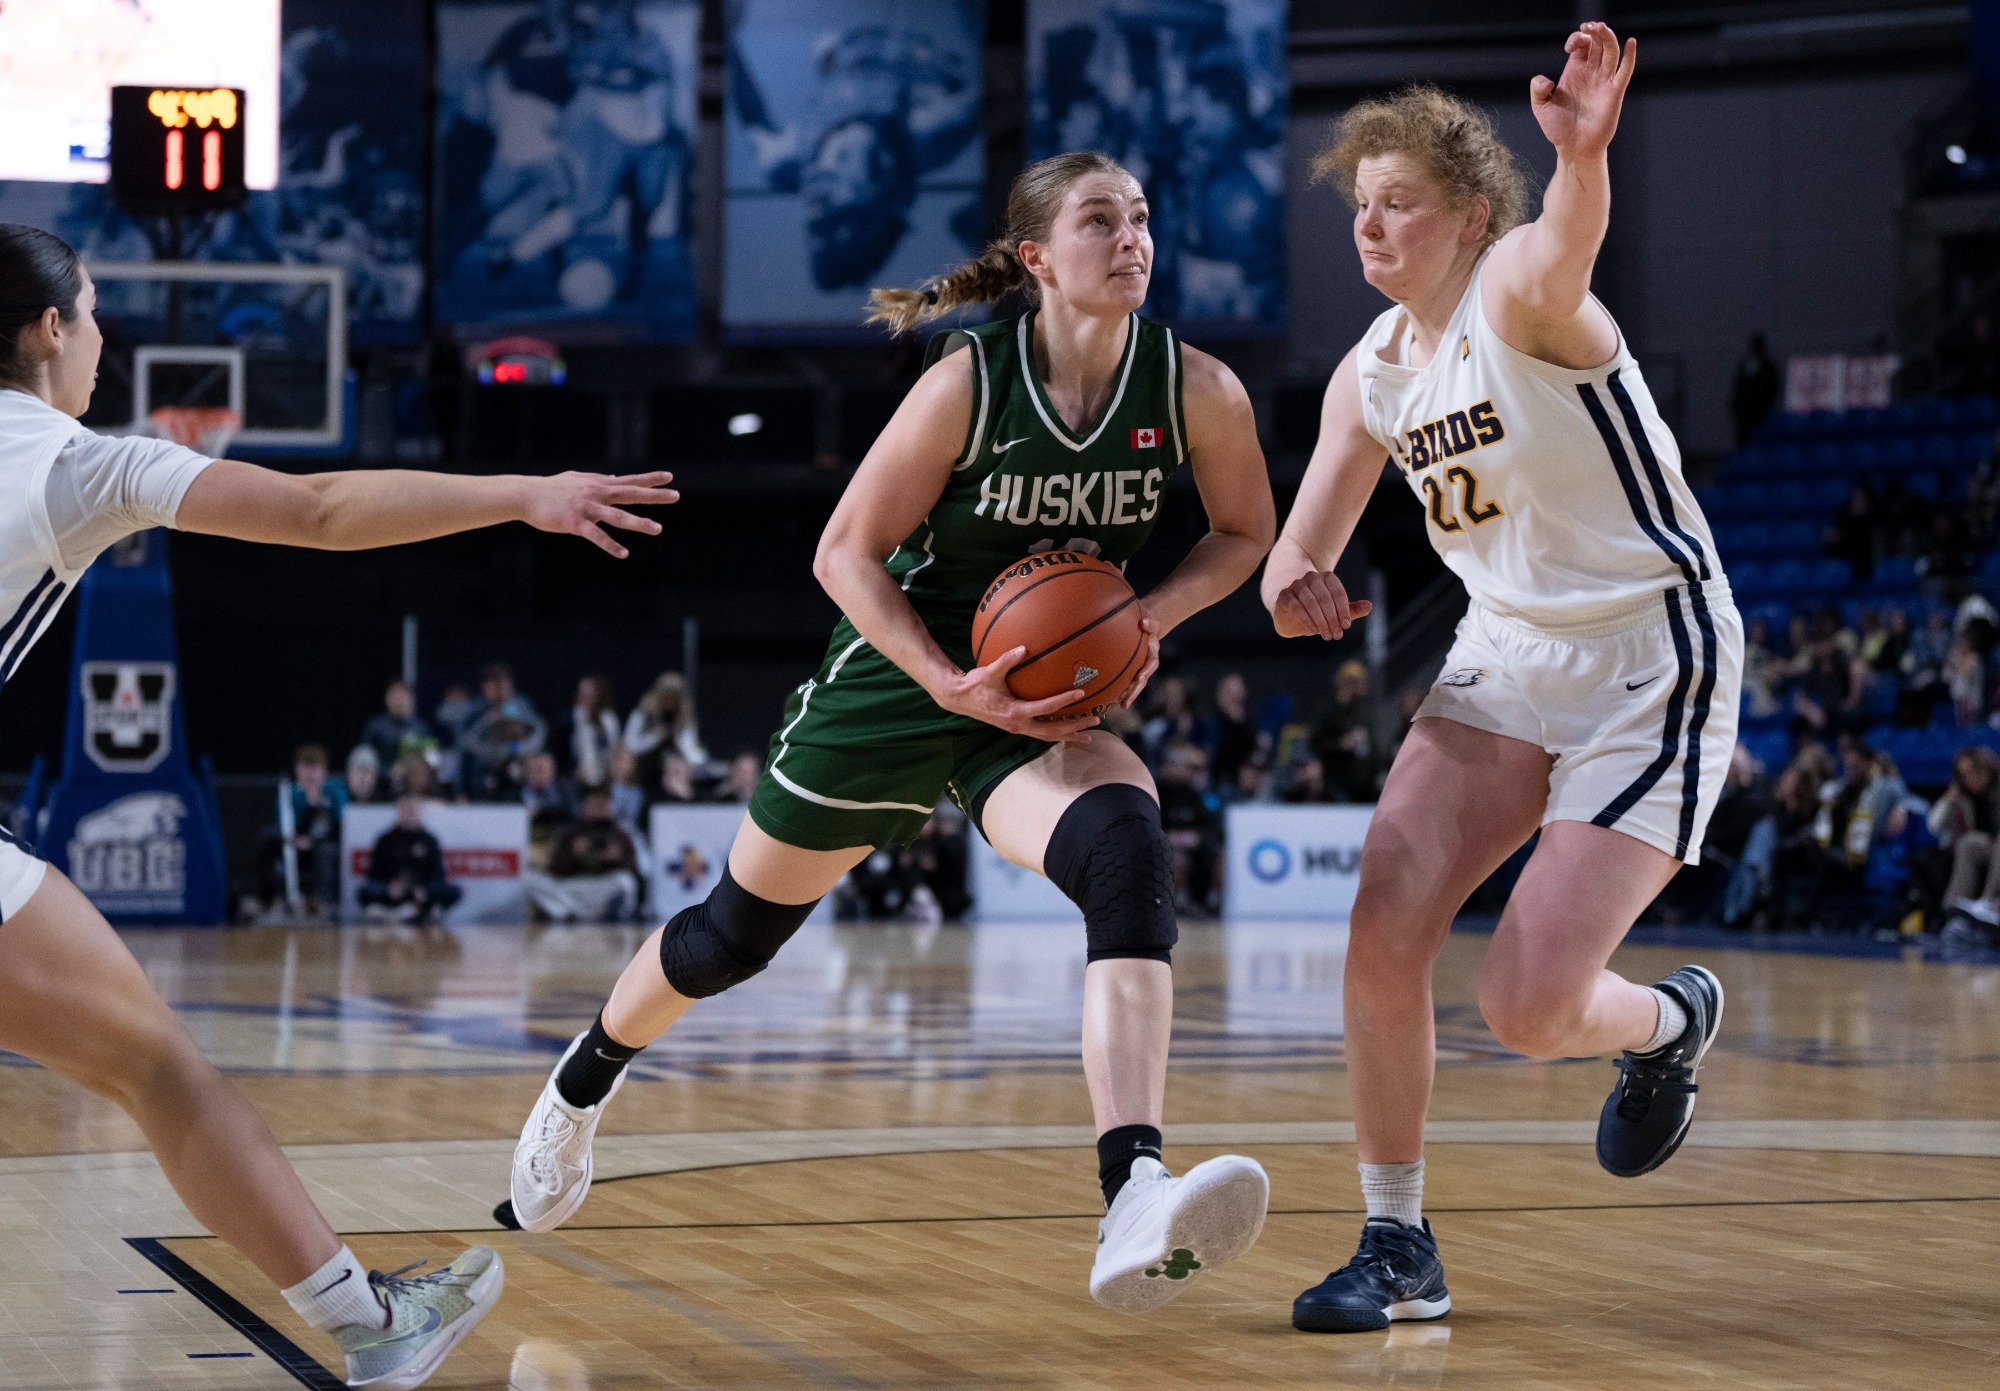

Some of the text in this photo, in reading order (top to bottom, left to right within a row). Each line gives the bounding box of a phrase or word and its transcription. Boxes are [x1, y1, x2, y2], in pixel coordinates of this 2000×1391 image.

[165, 129, 221, 191] 11
[974, 467, 1163, 526] HUSKIES
[1421, 464, 1505, 534] 22
